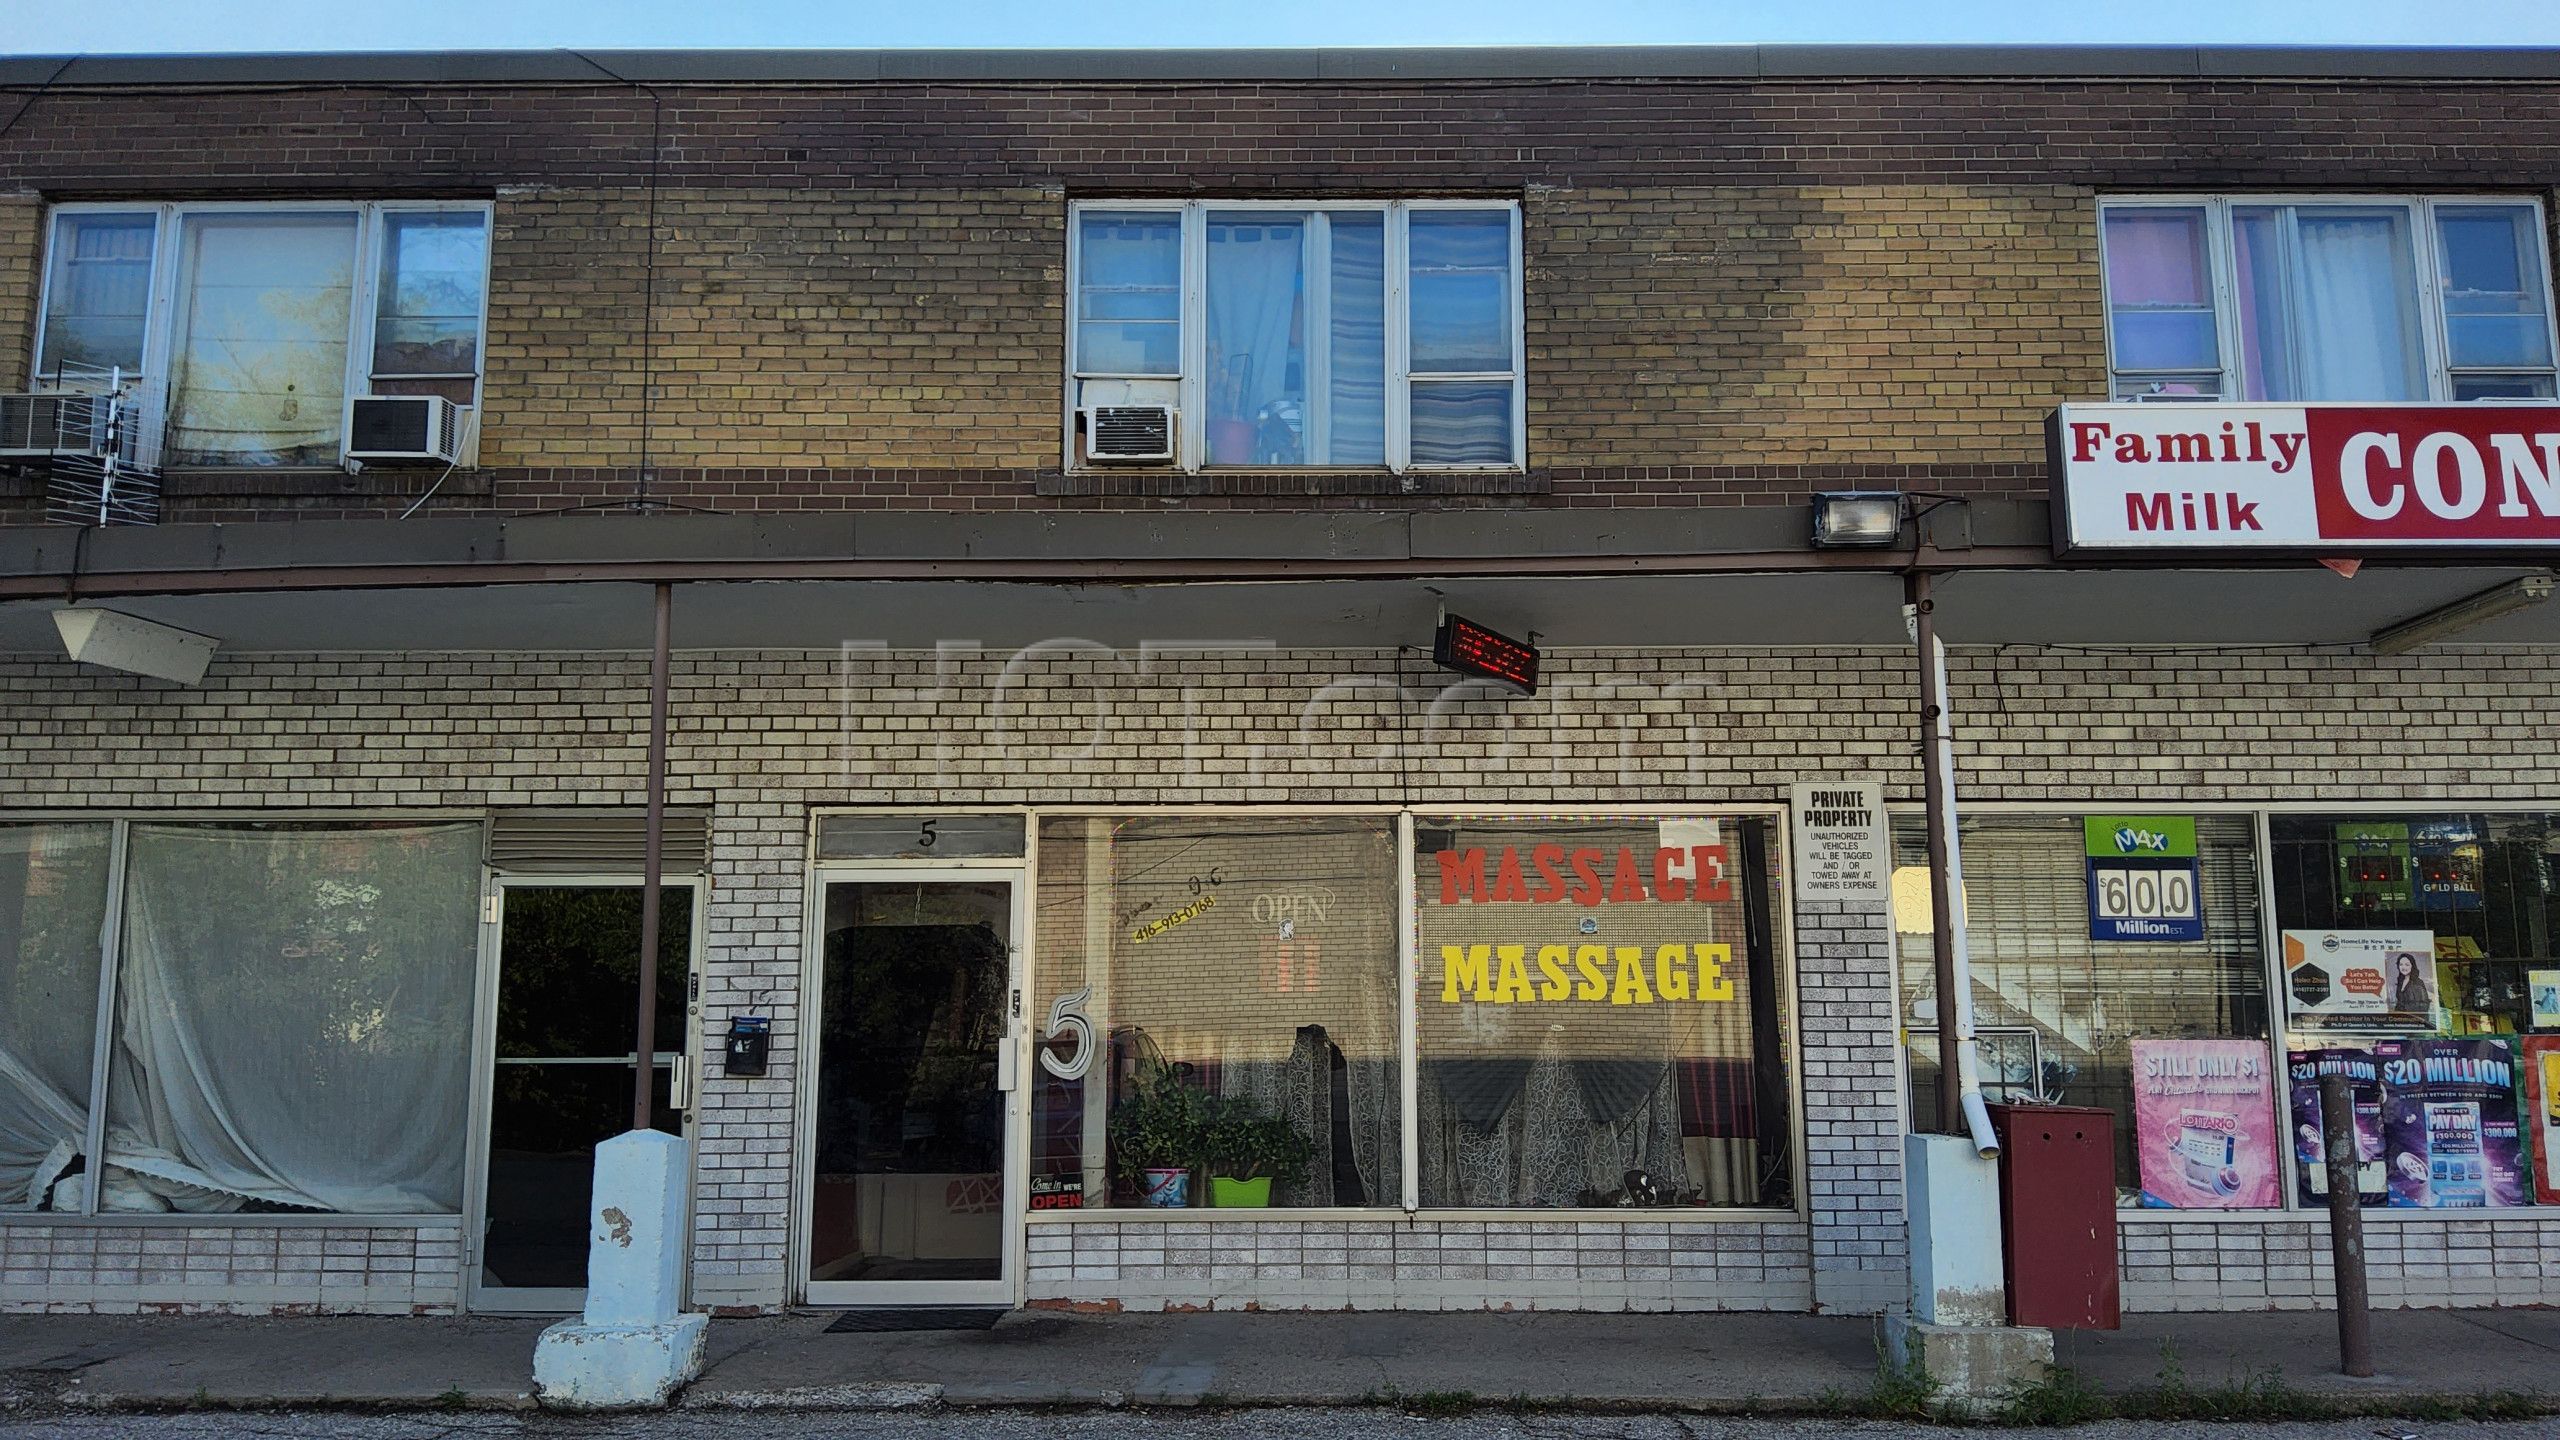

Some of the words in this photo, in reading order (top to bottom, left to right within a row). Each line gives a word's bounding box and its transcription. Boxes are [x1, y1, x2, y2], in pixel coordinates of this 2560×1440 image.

[2070, 421, 2306, 474] Family
[2339, 431, 2560, 521] CON
[2125, 492, 2264, 532] Milk
[1811, 790, 1864, 808] PRIVATE
[1804, 810, 1872, 827] PROPERTY
[919, 819, 938, 847] 5
[1810, 832, 1869, 841] UNAUTHORIZED
[2114, 828, 2166, 853] MAX
[1822, 842, 1859, 850] VEHICLES
[1809, 852, 1826, 860] WILL
[1829, 852, 1840, 860] BE
[1843, 852, 1873, 860] TAGGED
[1823, 861, 1839, 870] AND
[1849, 861, 1860, 870] OR
[1811, 871, 1839, 880] TOWED
[1841, 871, 1861, 880] AWAY
[1863, 871, 1872, 880] AT
[1807, 881, 1840, 890] OWNERS
[1843, 881, 1878, 890] EXPENSE
[2453, 883, 2475, 892] BALL
[1252, 893, 1328, 925] OPEN
[2115, 920, 2170, 935] Million
[1441, 943, 1733, 1005] MASSAGE
[1040, 983, 1097, 1081] 5
[2434, 1048, 2459, 1056] OVER
[2146, 1056, 2193, 1078] STILL
[2199, 1056, 2239, 1077] ONLY
[2291, 1062, 2316, 1080] $20
[2384, 1059, 2422, 1085] $20
[2425, 1057, 2511, 1088] MILLION
[2179, 1113, 2237, 1130] LOTTARIO
[1032, 1193, 1083, 1209] OPEN
